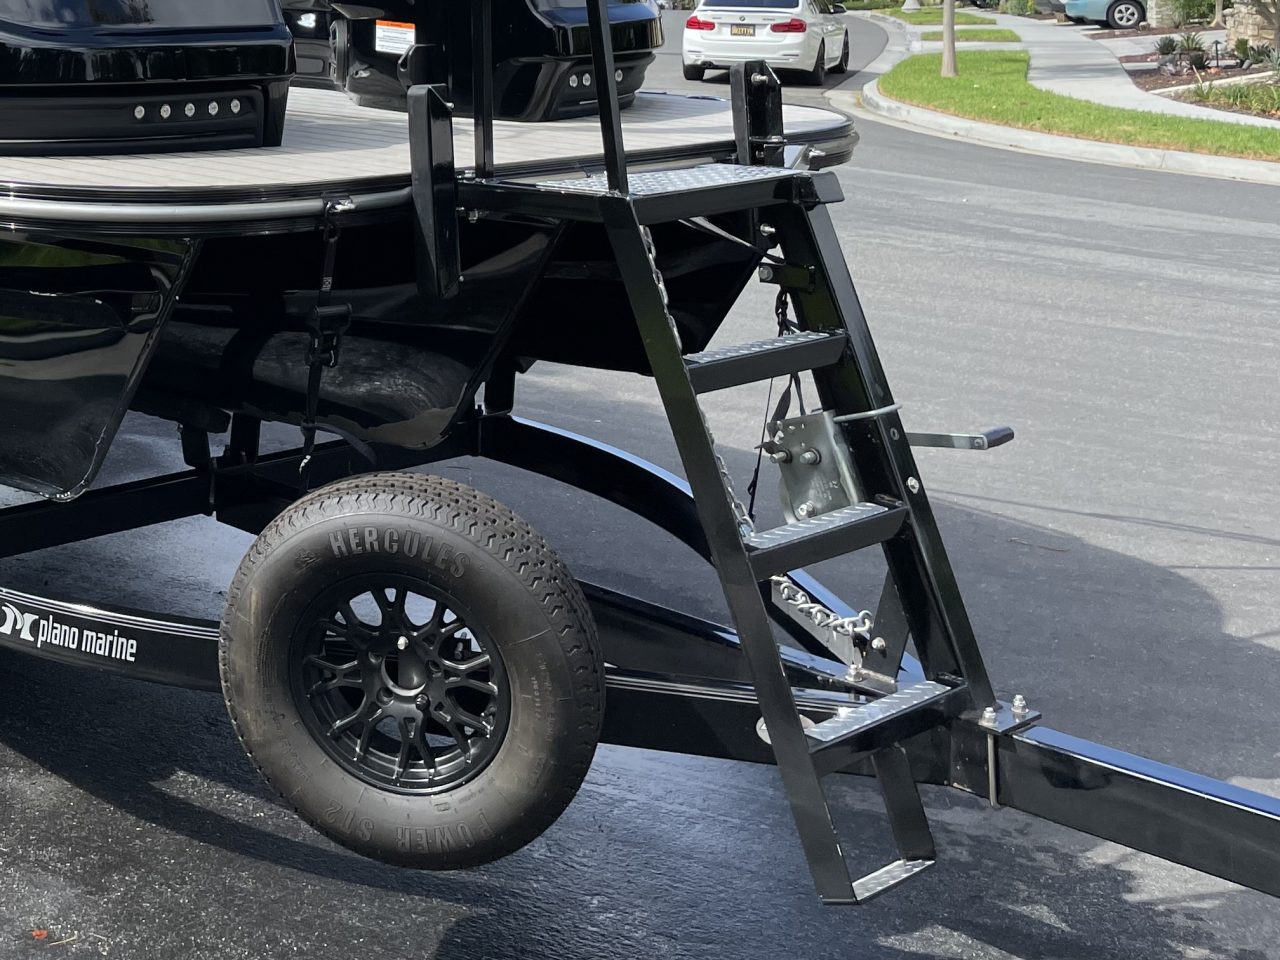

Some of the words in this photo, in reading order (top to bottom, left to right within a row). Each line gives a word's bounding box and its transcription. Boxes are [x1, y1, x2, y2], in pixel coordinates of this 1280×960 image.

[328, 526, 470, 578] HERCULES
[37, 614, 79, 649] plano
[81, 630, 138, 662] marine
